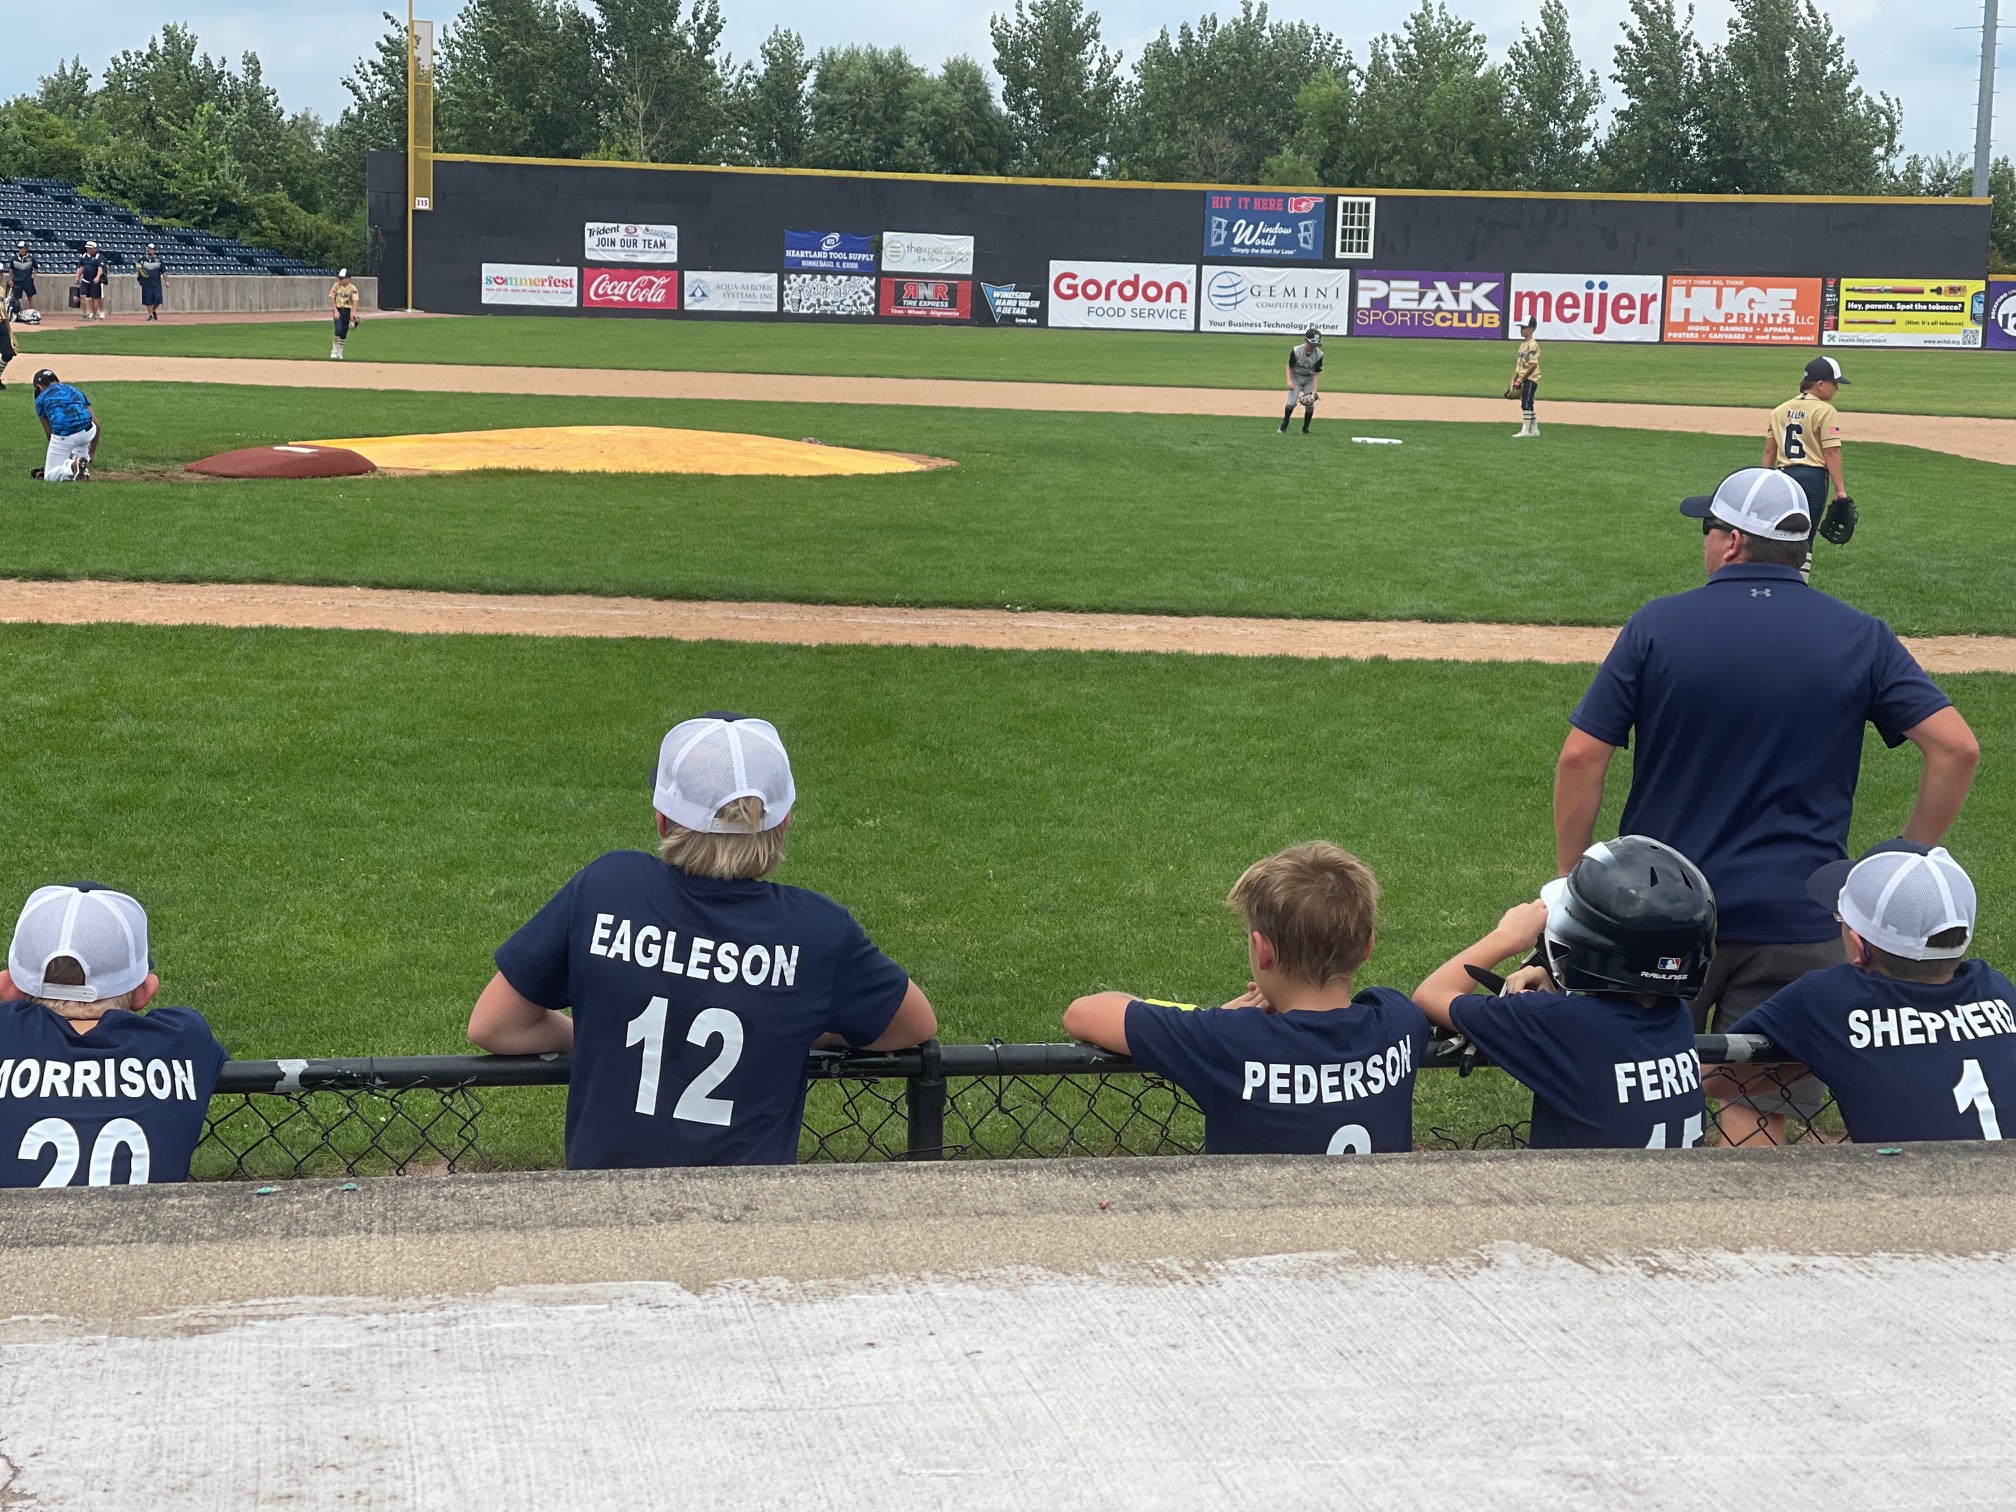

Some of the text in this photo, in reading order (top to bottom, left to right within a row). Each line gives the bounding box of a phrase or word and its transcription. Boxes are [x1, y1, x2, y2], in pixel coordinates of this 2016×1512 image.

[416, 198, 428, 207] 315
[1212, 196, 1284, 211] HIT IT HERE
[587, 225, 620, 238] Trident
[1232, 219, 1292, 245] Window
[596, 237, 667, 250] JOIN OUR TEAM
[786, 250, 874, 261] HEARTLAND TOOL SUPPLY
[589, 273, 672, 303] Coca-Cola
[715, 283, 776, 292] AQUA-AEROBIC
[803, 282, 834, 299] DAIRY
[993, 290, 1031, 300] WINDSOR
[1054, 271, 1187, 304] Gordon
[1250, 285, 1339, 299] GEMINI
[1357, 279, 1500, 311] PEAK
[1002, 307, 1027, 315] DETAIL
[1087, 306, 1187, 320] FOOD SERVICE
[1514, 280, 1658, 334] meijer
[1670, 286, 1797, 324] HUGE
[1228, 320, 1261, 328] Business
[1264, 321, 1307, 330] Technology
[1724, 312, 1814, 325] PRINTS LLC
[1784, 422, 1807, 460] 6
[590, 913, 799, 986] EAGLESON
[1640, 971, 1688, 980] RAWLINGS
[1848, 999, 2016, 1048] SHEPHERD
[626, 996, 744, 1126] 12
[1242, 1034, 1412, 1104] PEDERSON
[1952, 1059, 2002, 1140] 1
[18, 1117, 150, 1188] 20
